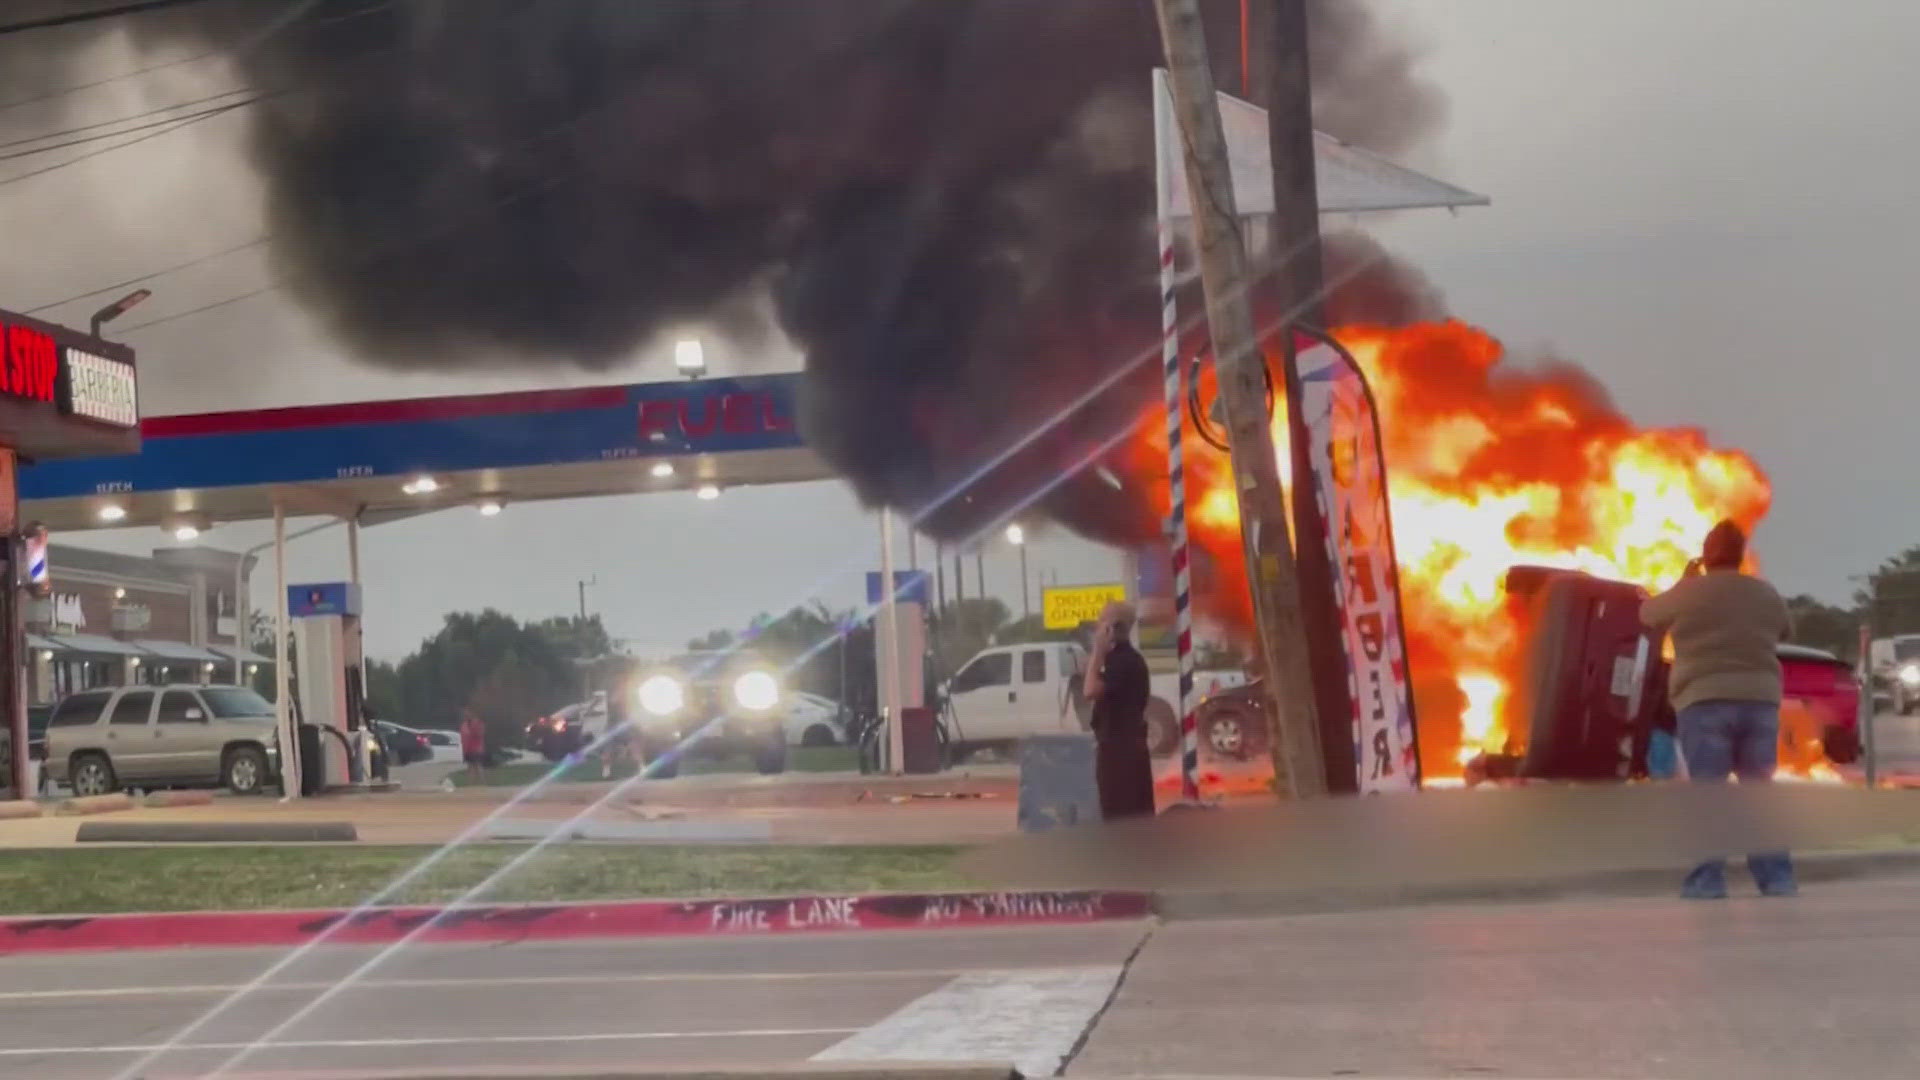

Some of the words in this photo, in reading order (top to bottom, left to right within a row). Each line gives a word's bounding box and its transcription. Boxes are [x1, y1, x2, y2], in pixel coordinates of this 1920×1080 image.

[8, 322, 58, 402] STOP
[639, 394, 792, 439] FUEL
[1055, 591, 1116, 606] DOLLAR
[712, 904, 771, 930] FIRE
[786, 896, 860, 928] LANE
